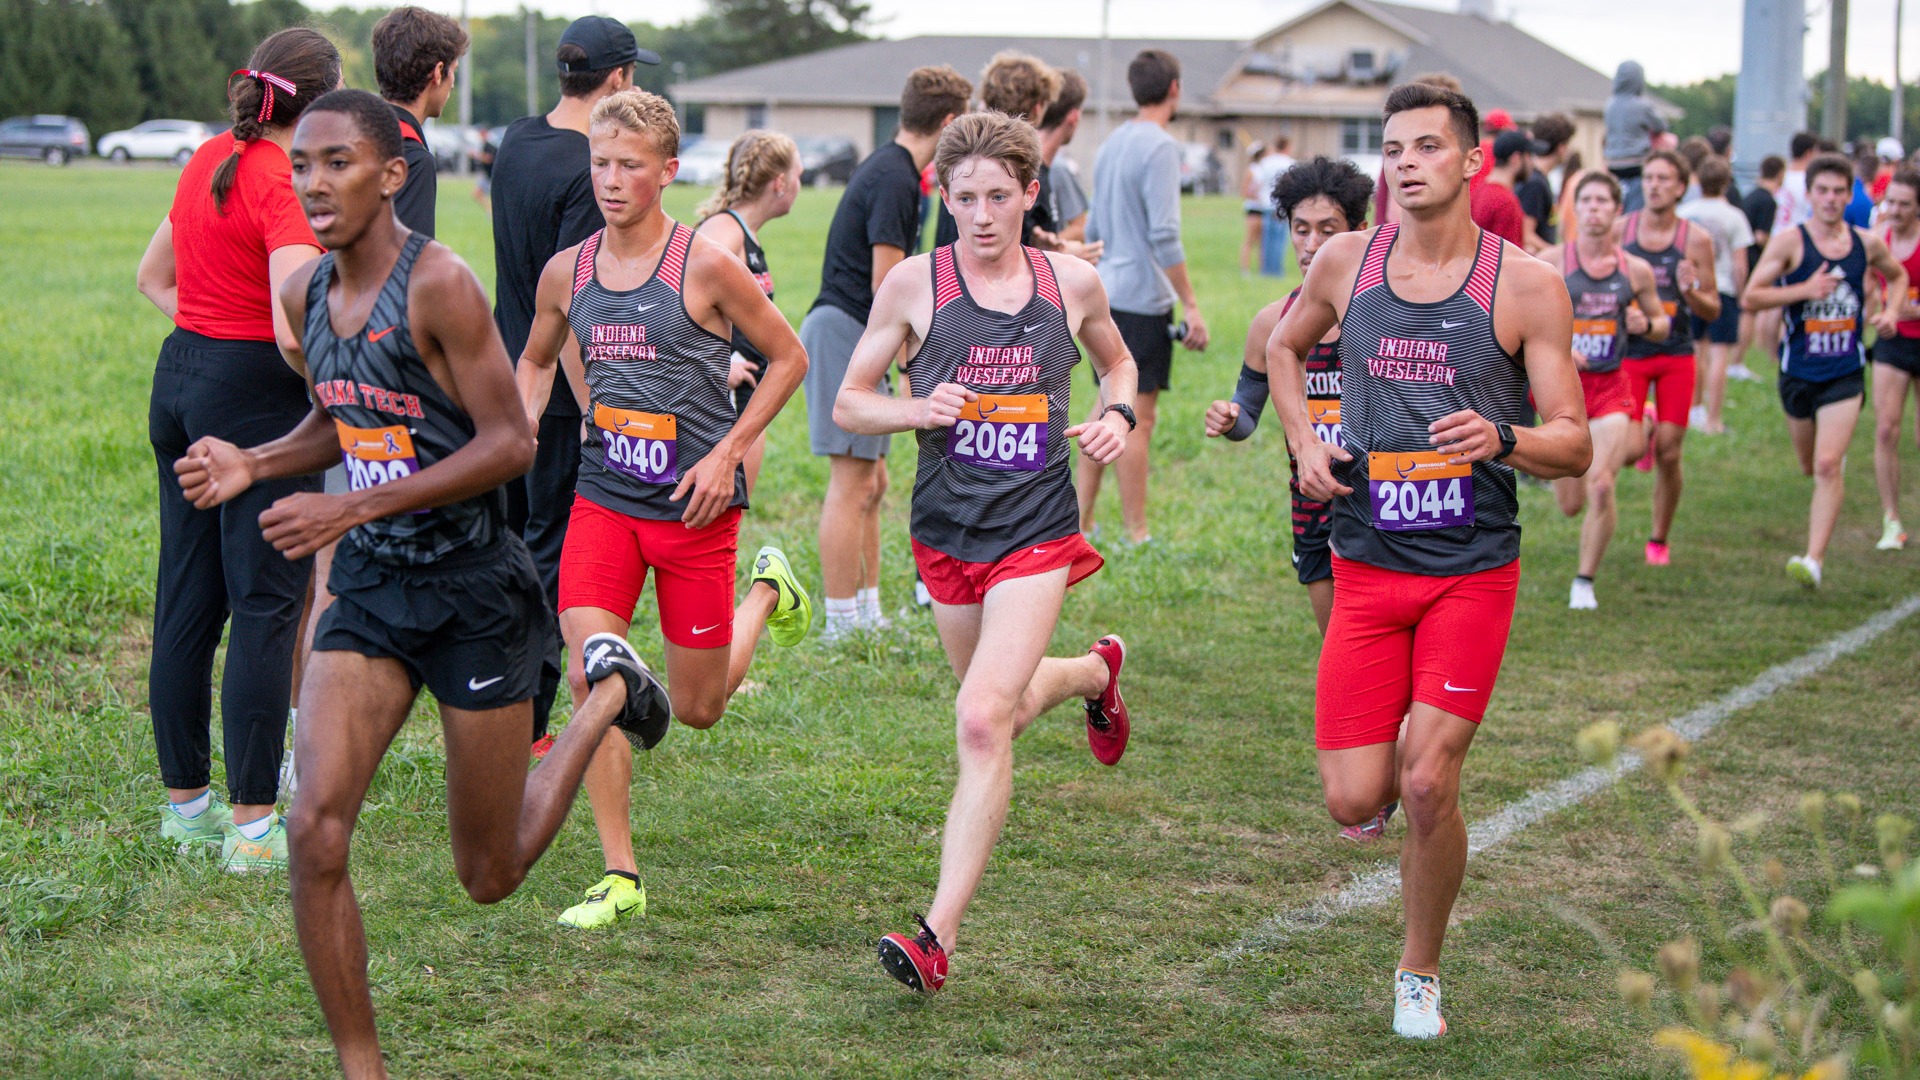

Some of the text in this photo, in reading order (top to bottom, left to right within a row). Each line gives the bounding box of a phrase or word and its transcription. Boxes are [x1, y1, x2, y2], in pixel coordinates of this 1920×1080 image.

[591, 324, 647, 342] INDIANA
[1808, 330, 1851, 354] 2117
[586, 345, 658, 361] WESLEYAN
[968, 345, 1033, 364] INDIANA
[1377, 337, 1449, 362] INDIANA
[956, 365, 1041, 385] WESLEYAN
[1367, 359, 1457, 387] WESLEYAN
[358, 383, 426, 420] TECH
[603, 430, 668, 475] 2040
[954, 420, 1038, 462] 2064
[1378, 477, 1466, 521] 2044
